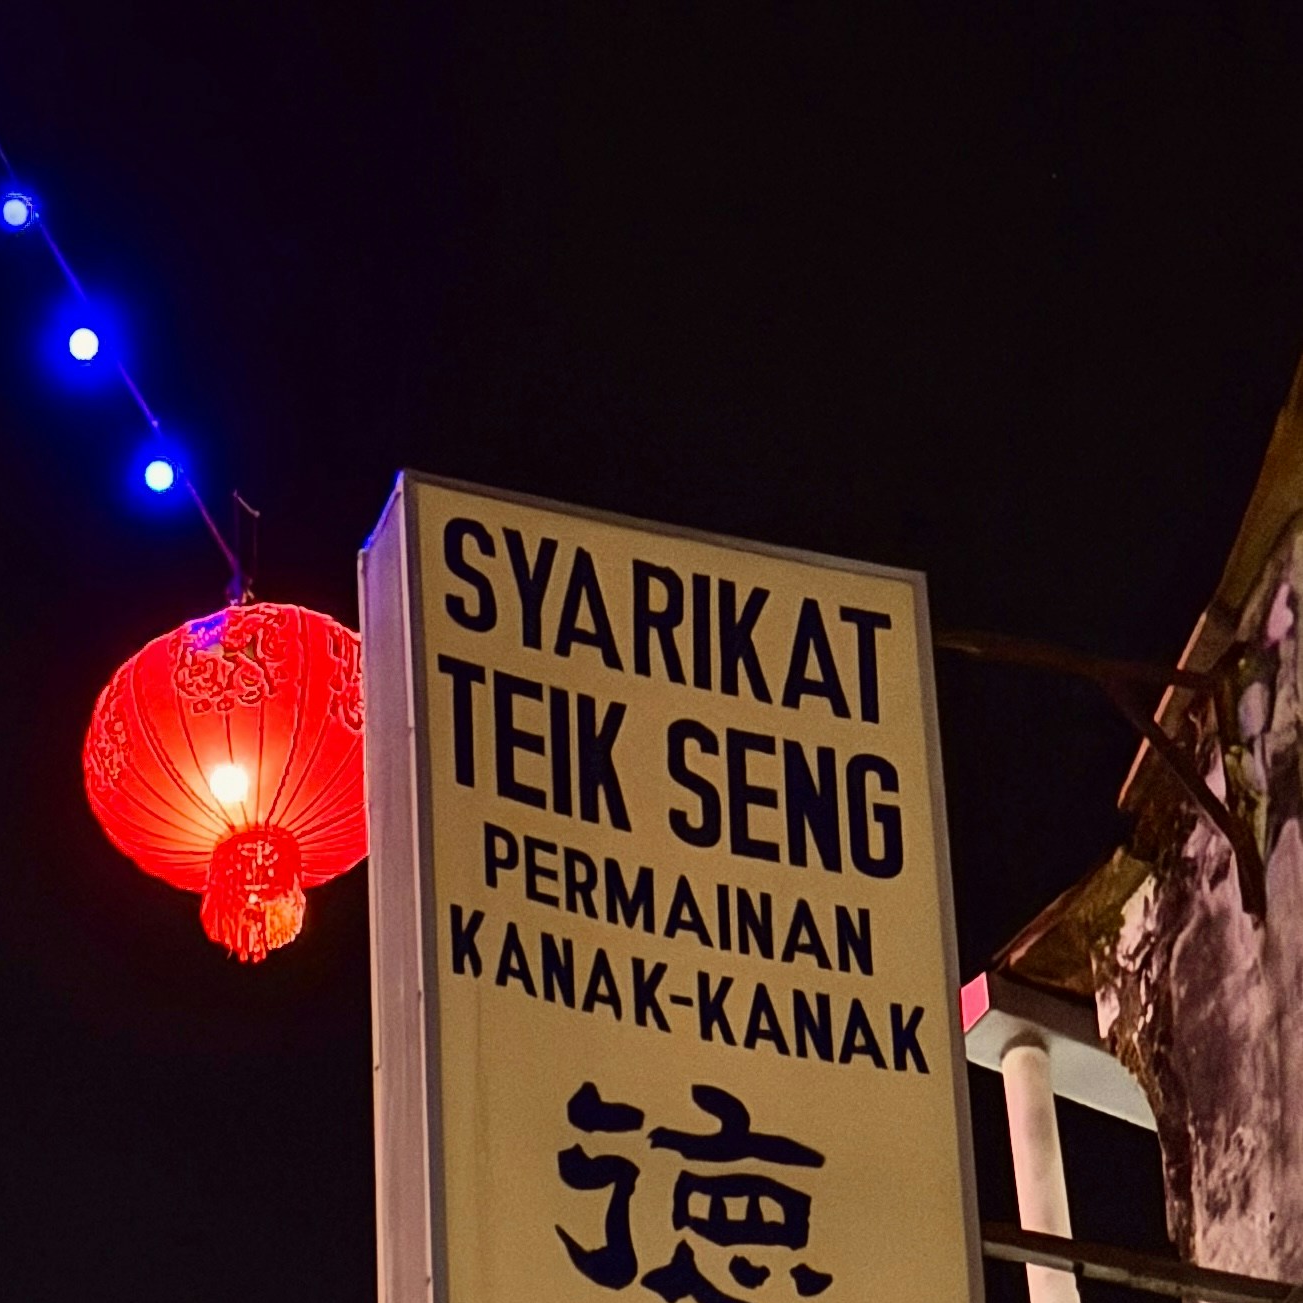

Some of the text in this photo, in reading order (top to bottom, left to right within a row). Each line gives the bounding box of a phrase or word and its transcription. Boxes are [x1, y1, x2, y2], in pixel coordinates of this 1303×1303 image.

[443, 517, 892, 725] SYARIKAT
[437, 653, 904, 879] TEIK SENG
[449, 903, 930, 1075] KANAK-KANAK
[483, 821, 874, 977] PERMAINAN
